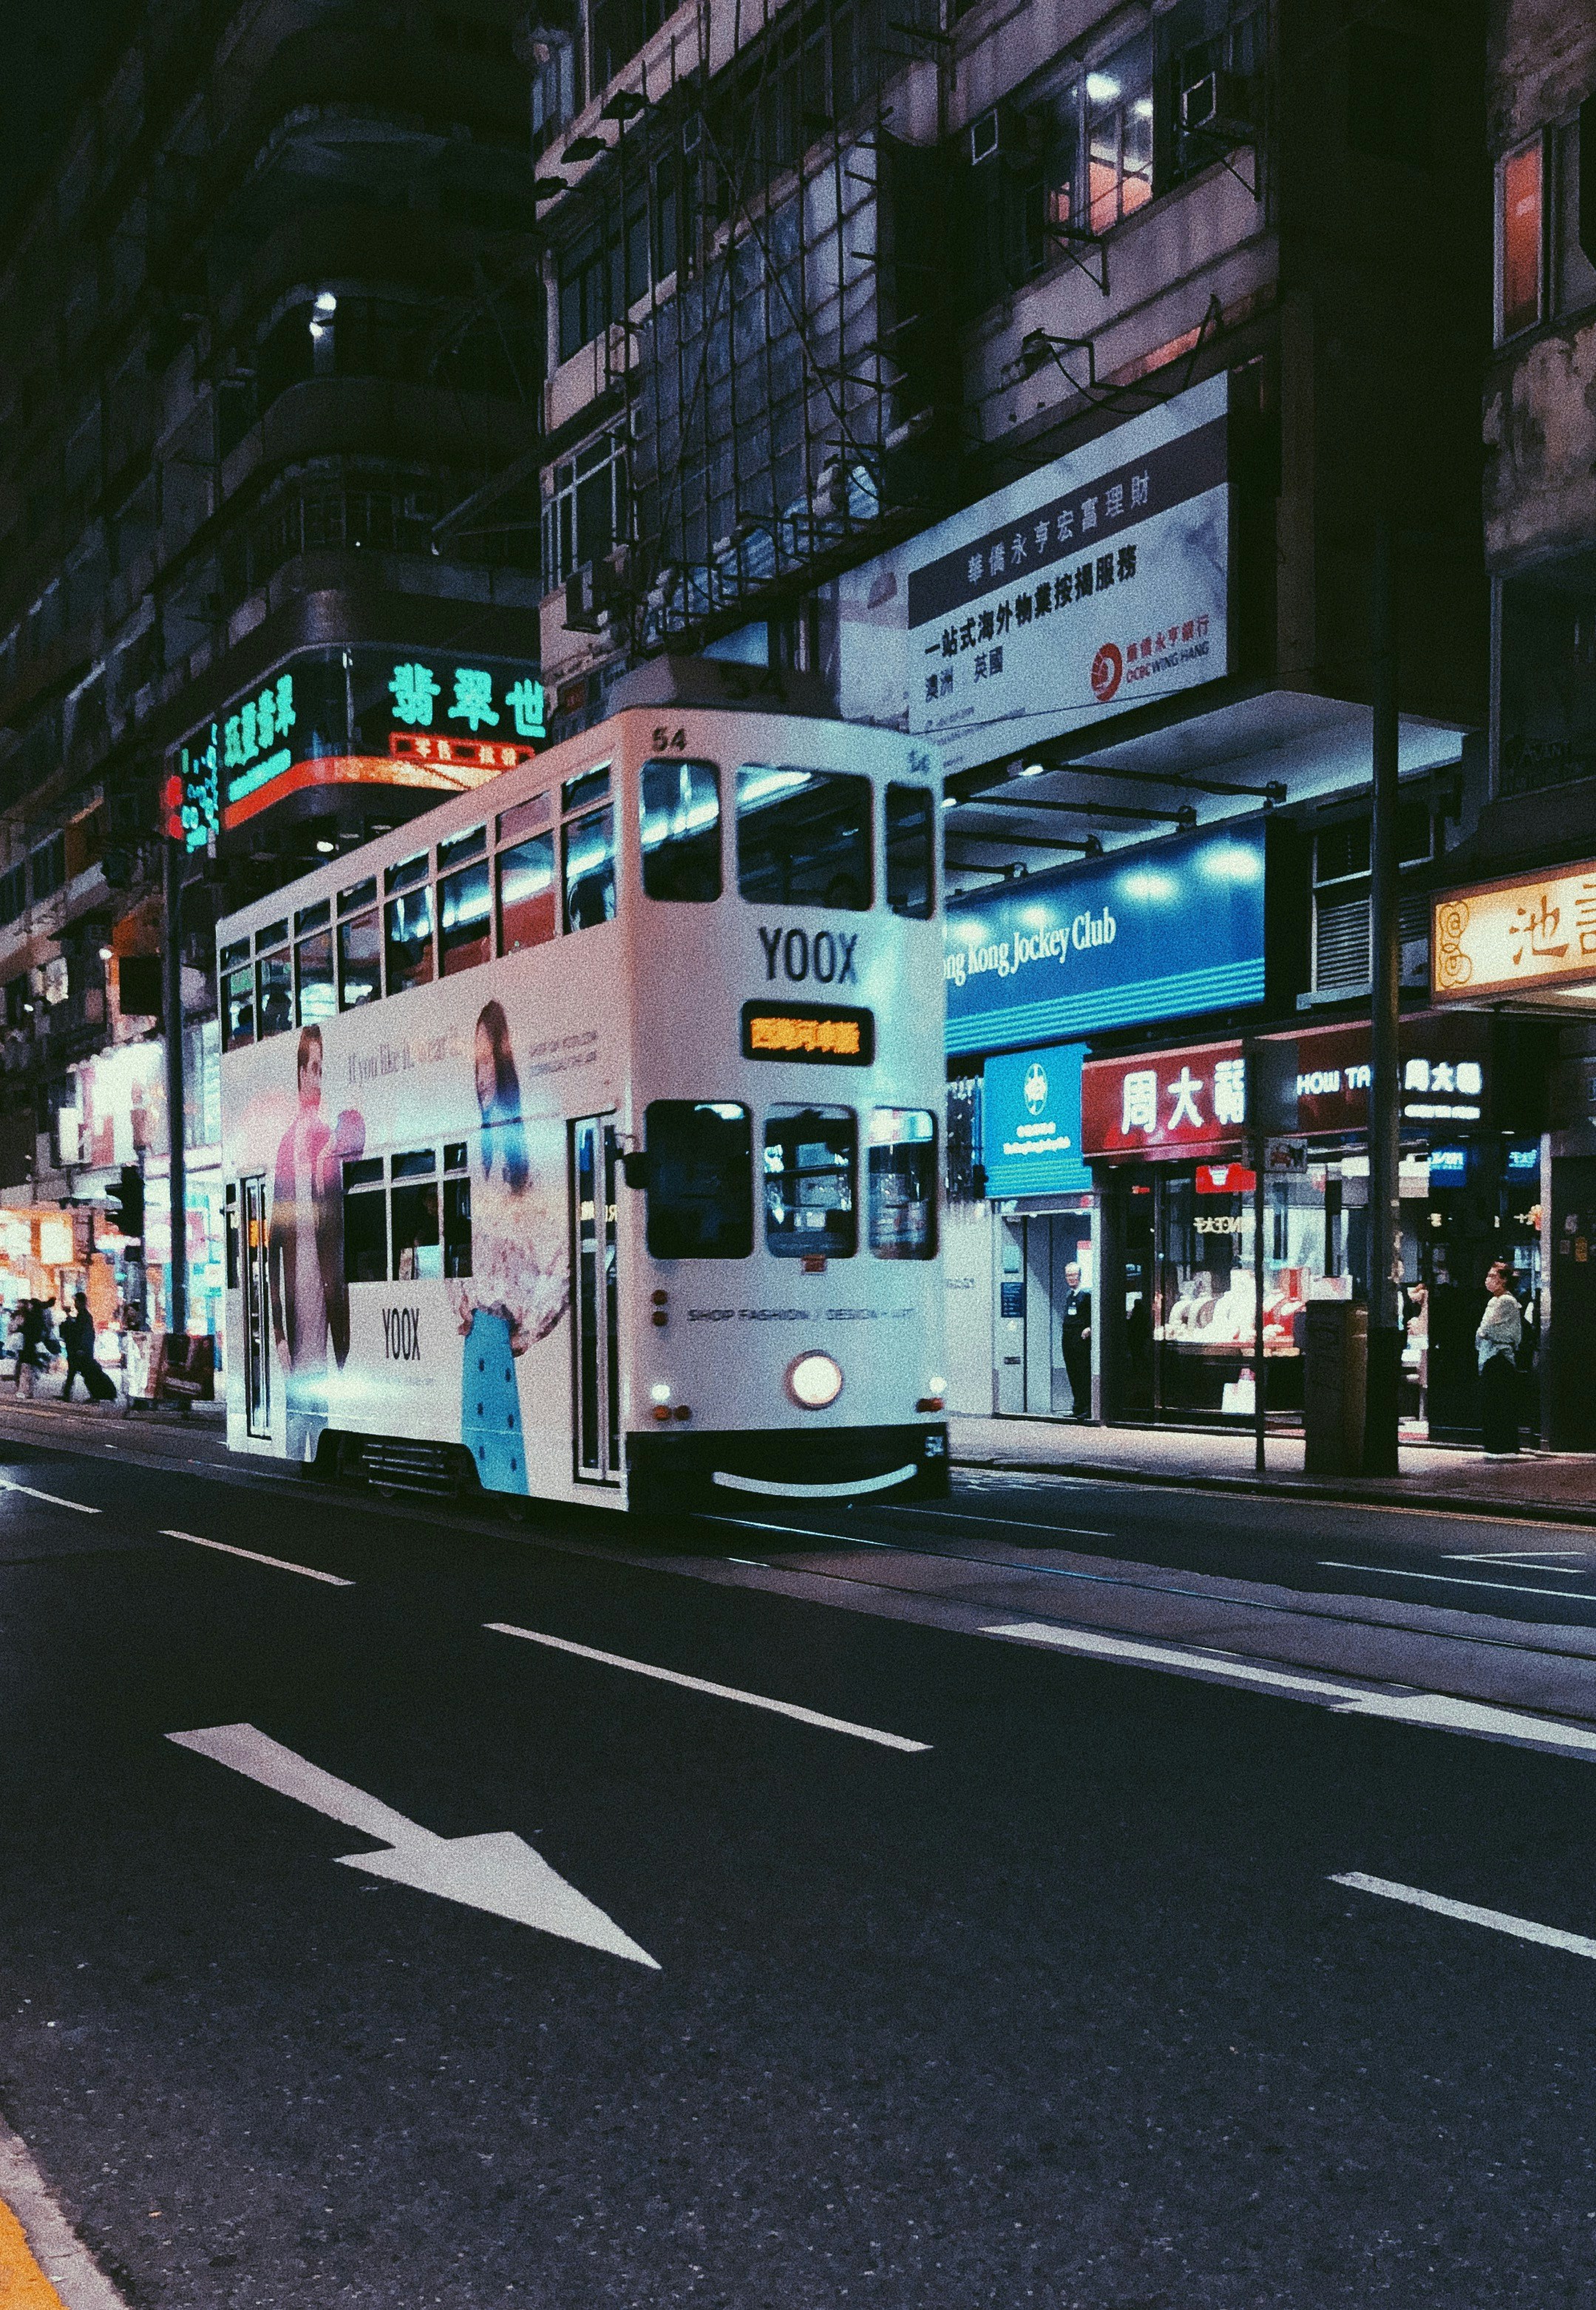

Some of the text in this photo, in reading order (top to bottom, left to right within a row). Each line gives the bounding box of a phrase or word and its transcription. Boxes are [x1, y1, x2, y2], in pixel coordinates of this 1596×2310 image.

[967, 470, 1150, 584] 華僑永亨宏富理財
[924, 544, 1138, 658] 一站式海外物業按揭服務
[973, 646, 1003, 683] 英國
[388, 663, 545, 738] 翡翠世
[652, 727, 687, 753] 54
[758, 927, 858, 983] YOOX
[968, 942, 1010, 978] Kong
[1011, 924, 1070, 974] Jockey
[1071, 906, 1116, 951] Club
[1297, 1065, 1372, 1096] HOW TA
[382, 1307, 421, 1361] YOOX
[687, 1309, 735, 1321] SHOP
